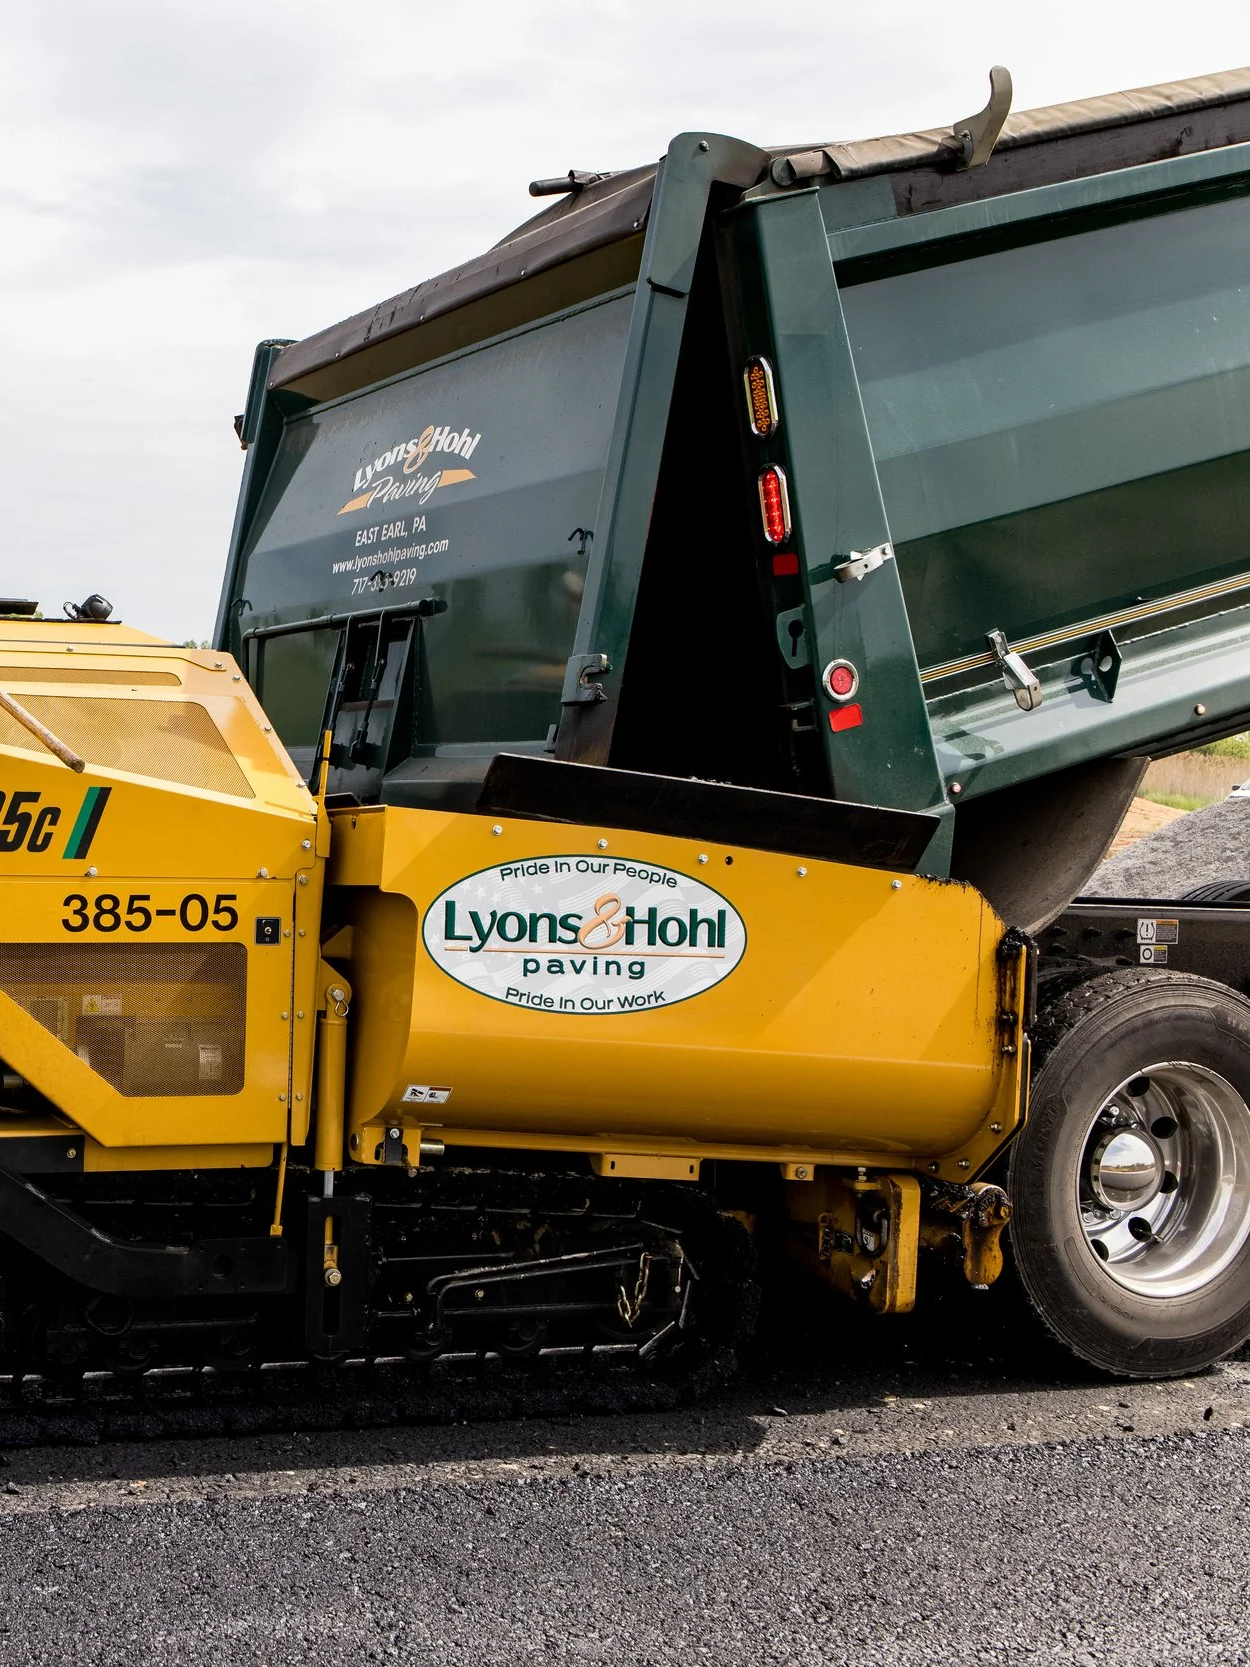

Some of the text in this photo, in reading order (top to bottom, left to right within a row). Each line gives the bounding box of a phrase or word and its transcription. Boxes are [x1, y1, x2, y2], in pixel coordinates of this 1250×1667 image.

[366, 469, 444, 509] Paving
[355, 515, 427, 547] EAST EARL, PA
[332, 538, 449, 574] www.lyonshohlpaving.com
[500, 860, 678, 889] Pride In Our People
[61, 892, 239, 933] 385-05
[522, 955, 646, 980] paving
[505, 986, 666, 1012] Pride In Our Work
